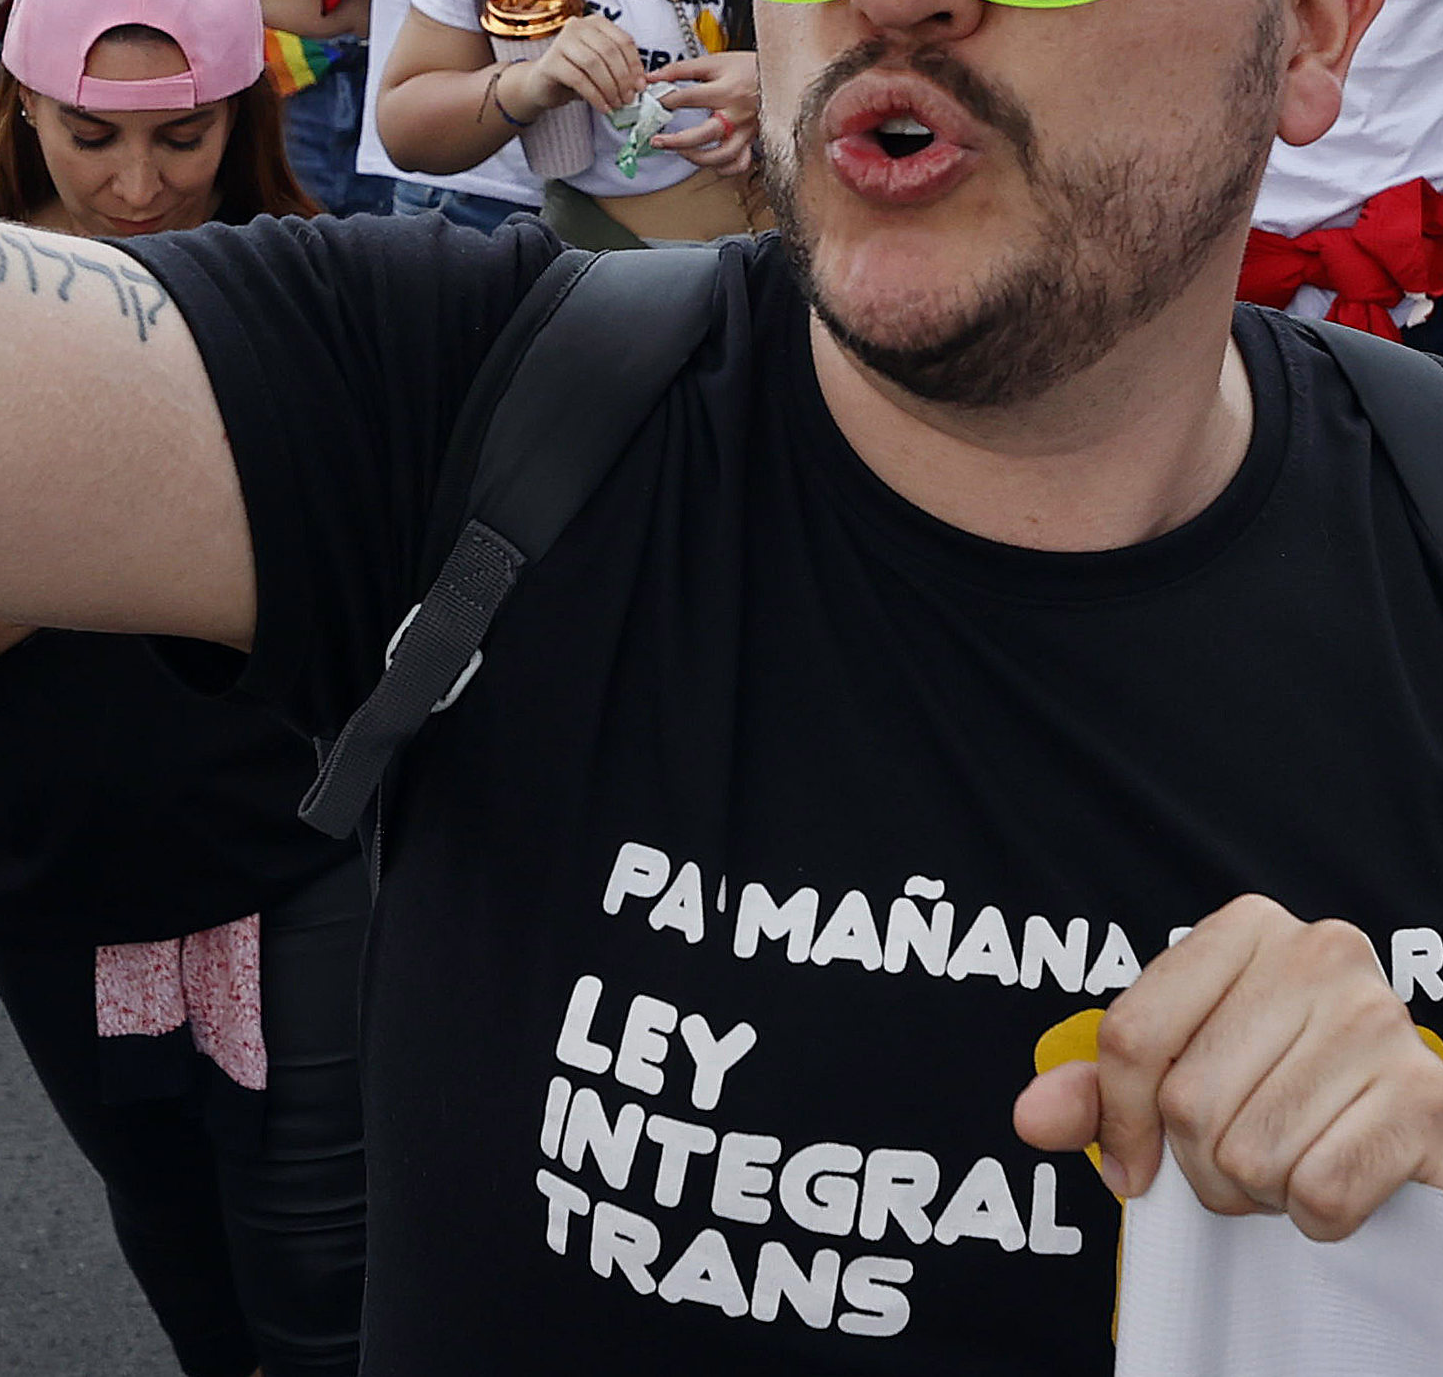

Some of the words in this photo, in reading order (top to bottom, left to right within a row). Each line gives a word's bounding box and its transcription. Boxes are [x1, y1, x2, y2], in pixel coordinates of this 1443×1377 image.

[734, 875, 1142, 995] MAÑANA
[555, 975, 757, 1110] LEY
[540, 1076, 1082, 1255] INTEGRAL
[536, 1168, 913, 1337] TRANS
